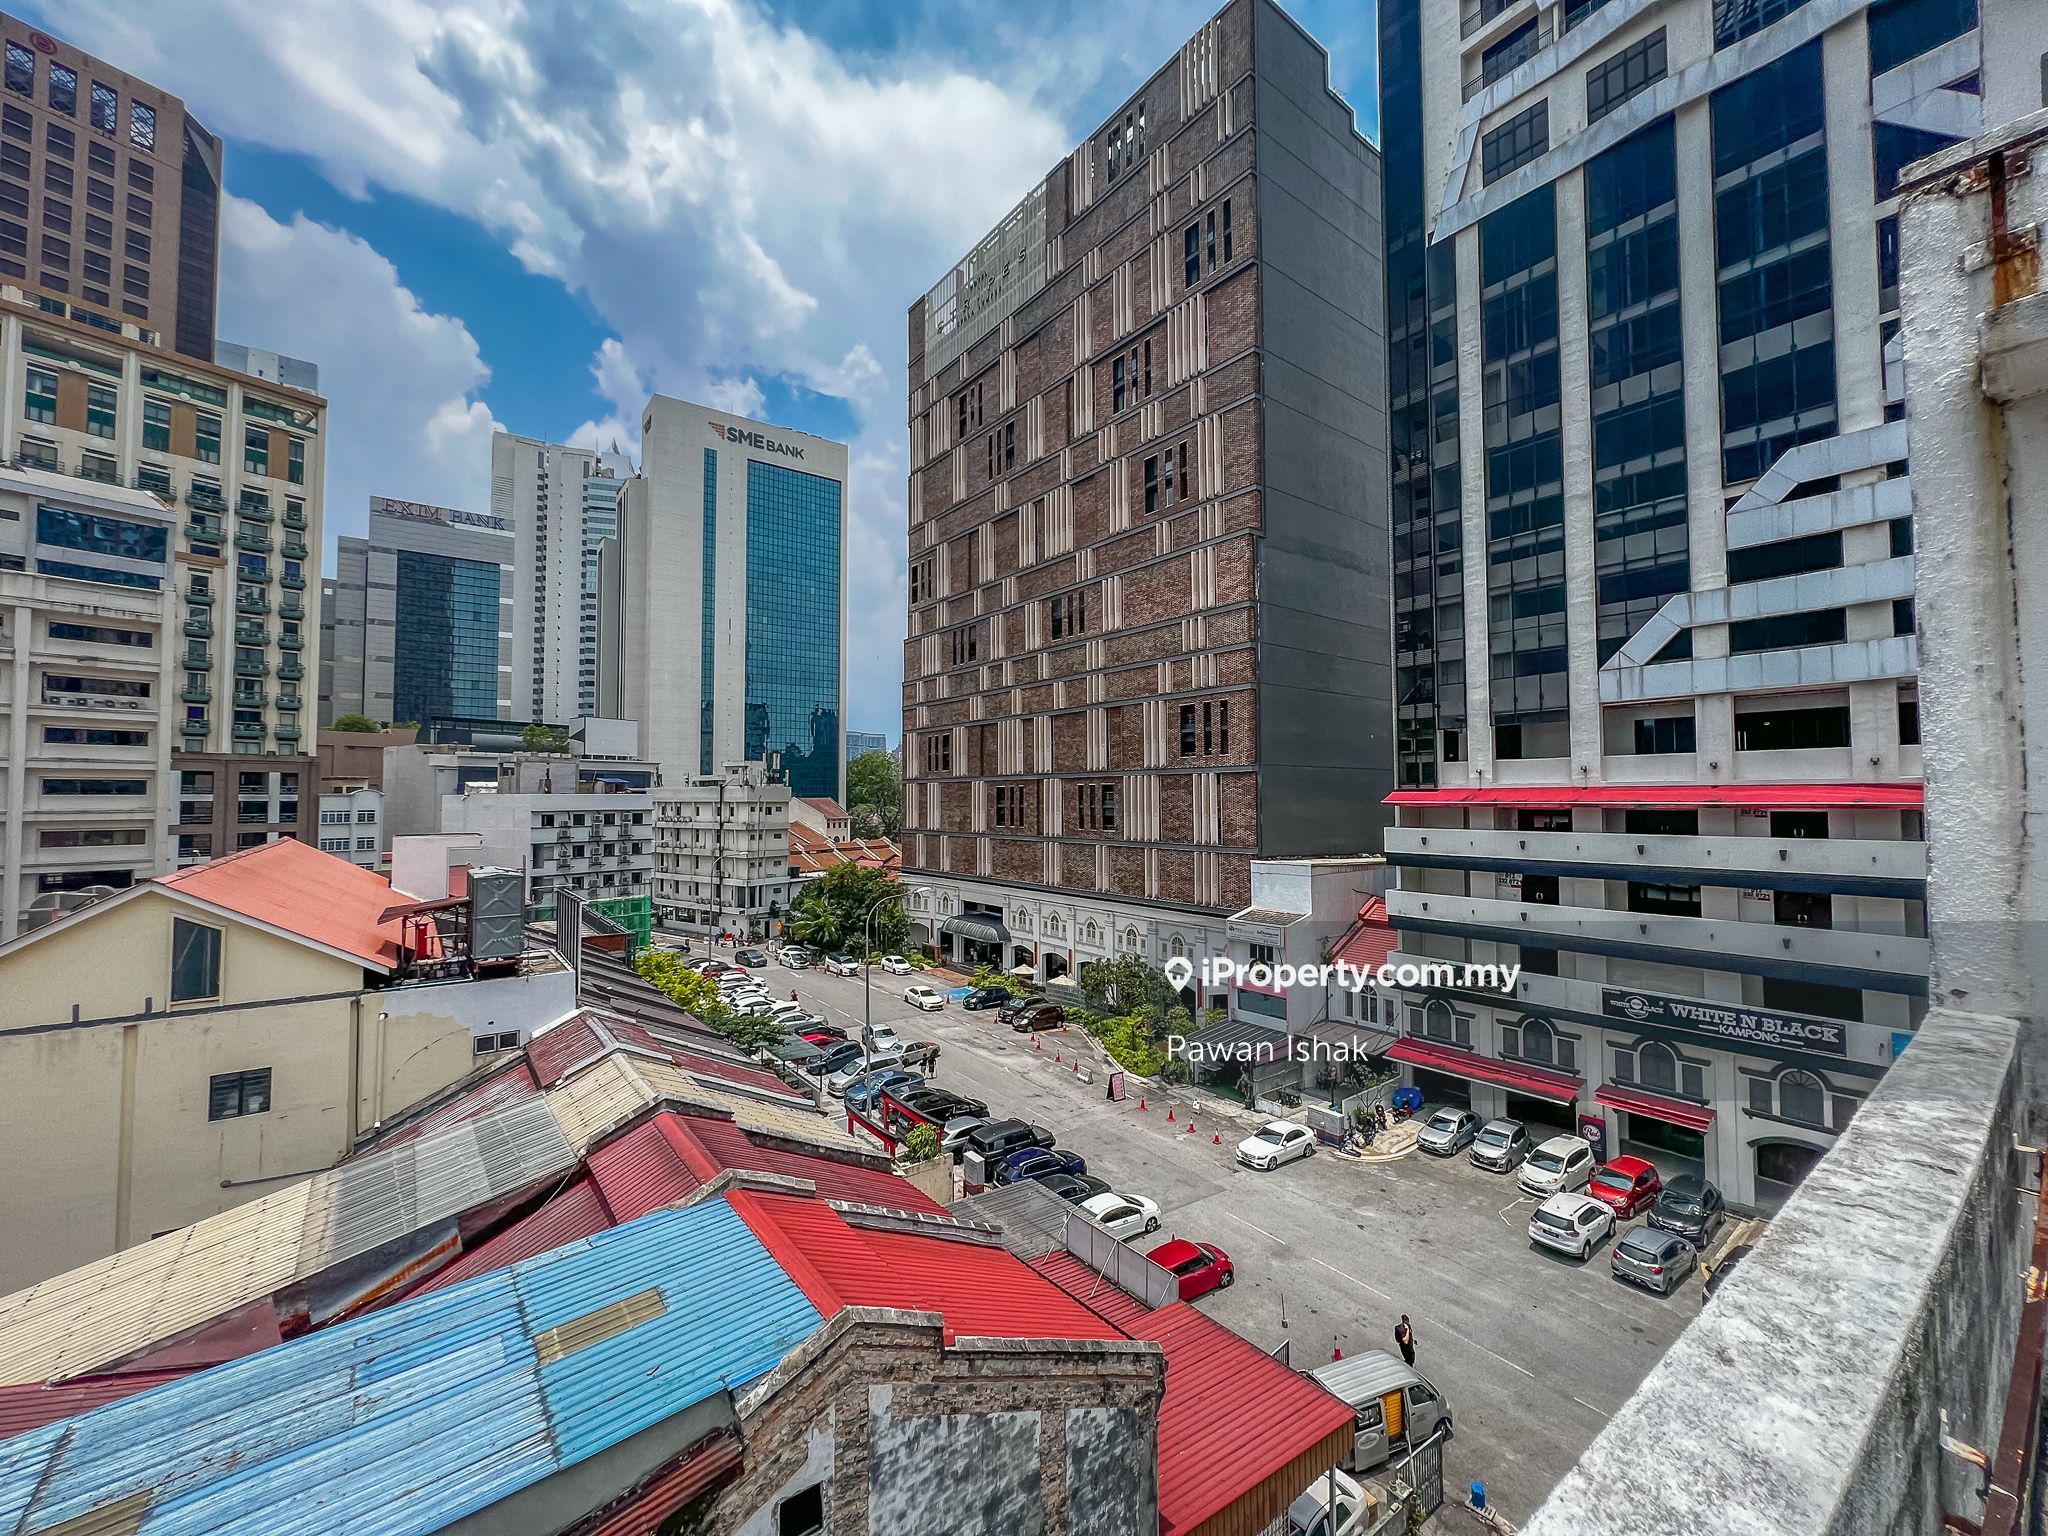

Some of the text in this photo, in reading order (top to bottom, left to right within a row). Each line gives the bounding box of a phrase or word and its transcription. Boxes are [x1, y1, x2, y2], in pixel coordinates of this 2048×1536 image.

[937, 247, 1027, 334] STRPES
[727, 427, 804, 460] SME BANK
[382, 499, 505, 530] EXIM BANK
[1670, 1003, 1839, 1043] WHITE N BLACK
[1718, 1025, 1780, 1043] KAMPONG
